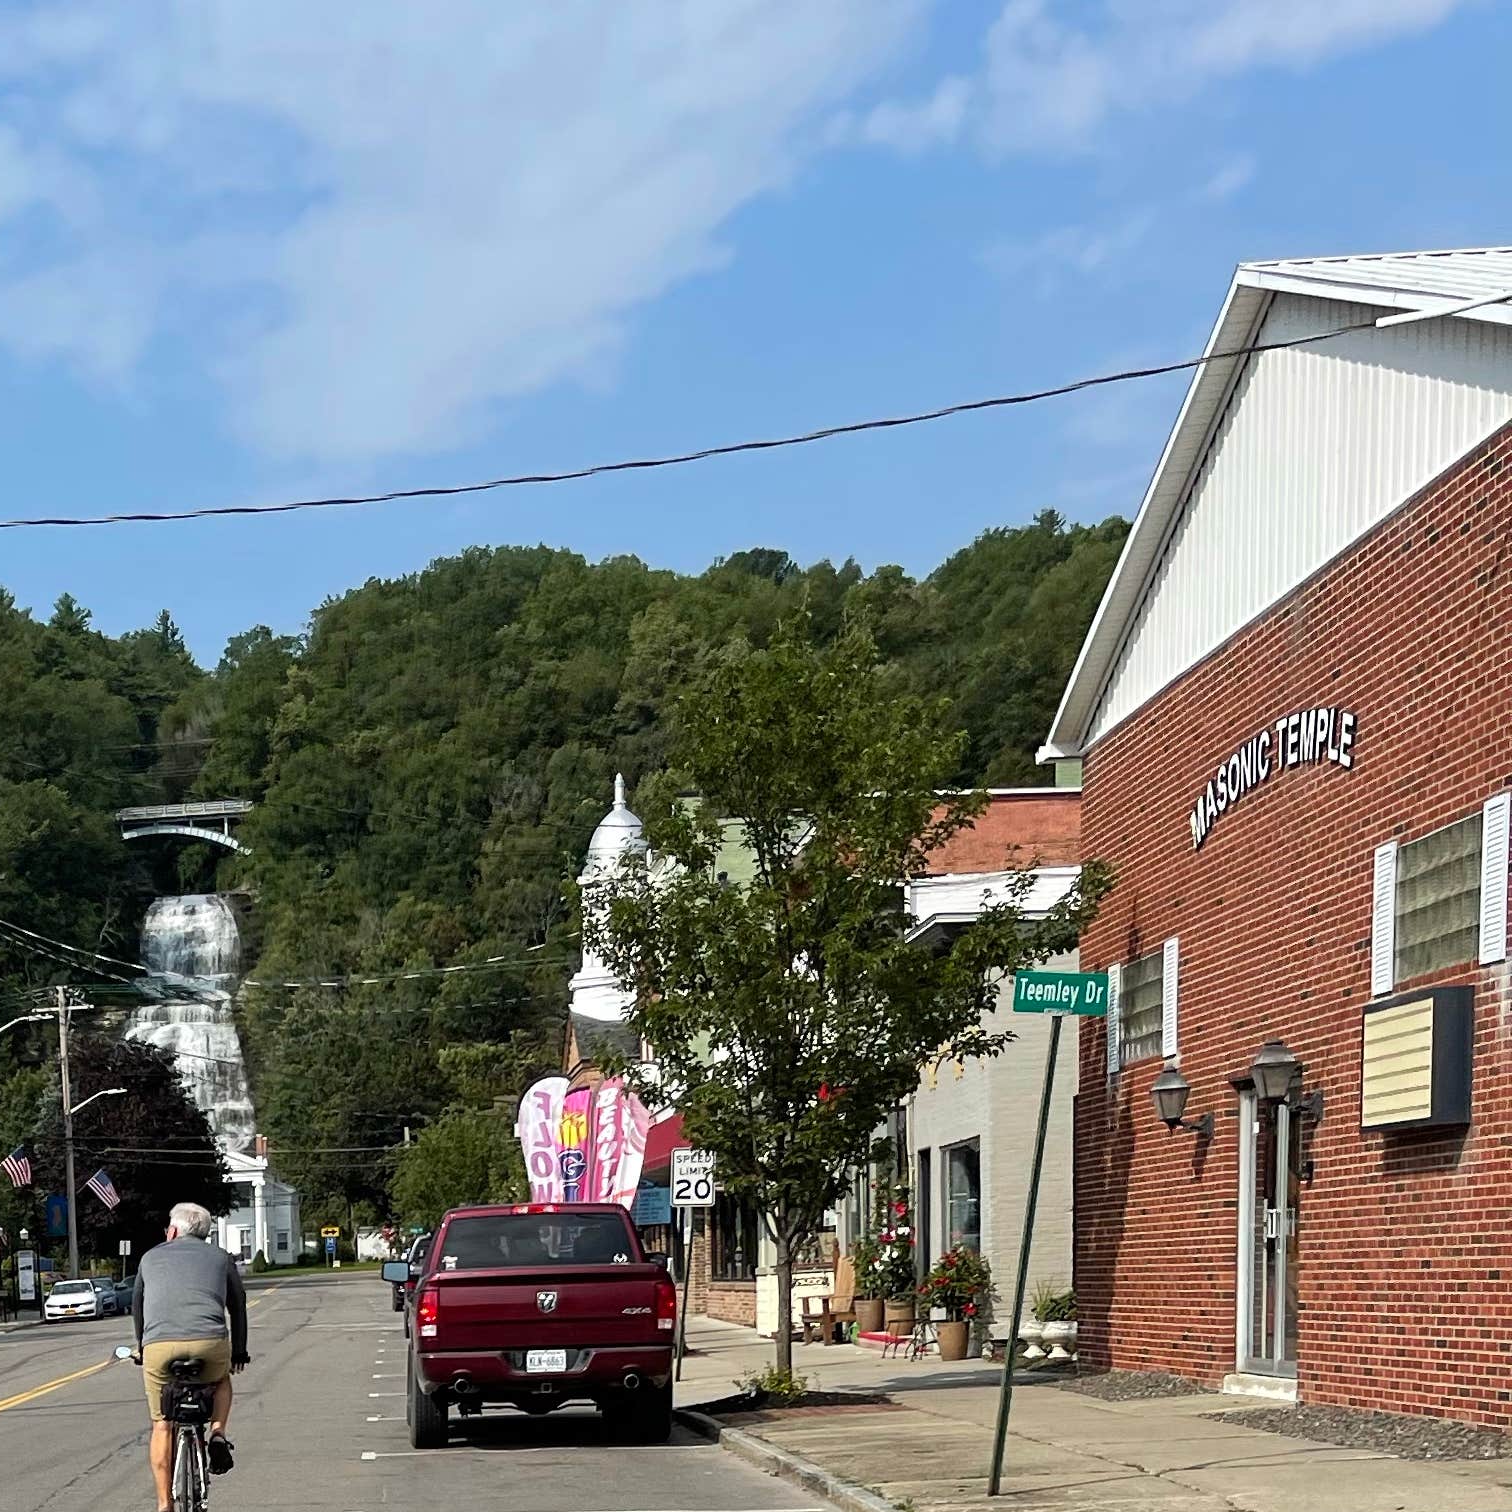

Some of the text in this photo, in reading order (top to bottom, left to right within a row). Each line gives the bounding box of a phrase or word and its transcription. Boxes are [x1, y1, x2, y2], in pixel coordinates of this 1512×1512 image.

[1190, 708, 1354, 849] MASONIC TEMPLE
[1020, 977, 1104, 1008] Teemley Dr
[676, 1154, 712, 1164] SPEED
[675, 1179, 711, 1200] 20
